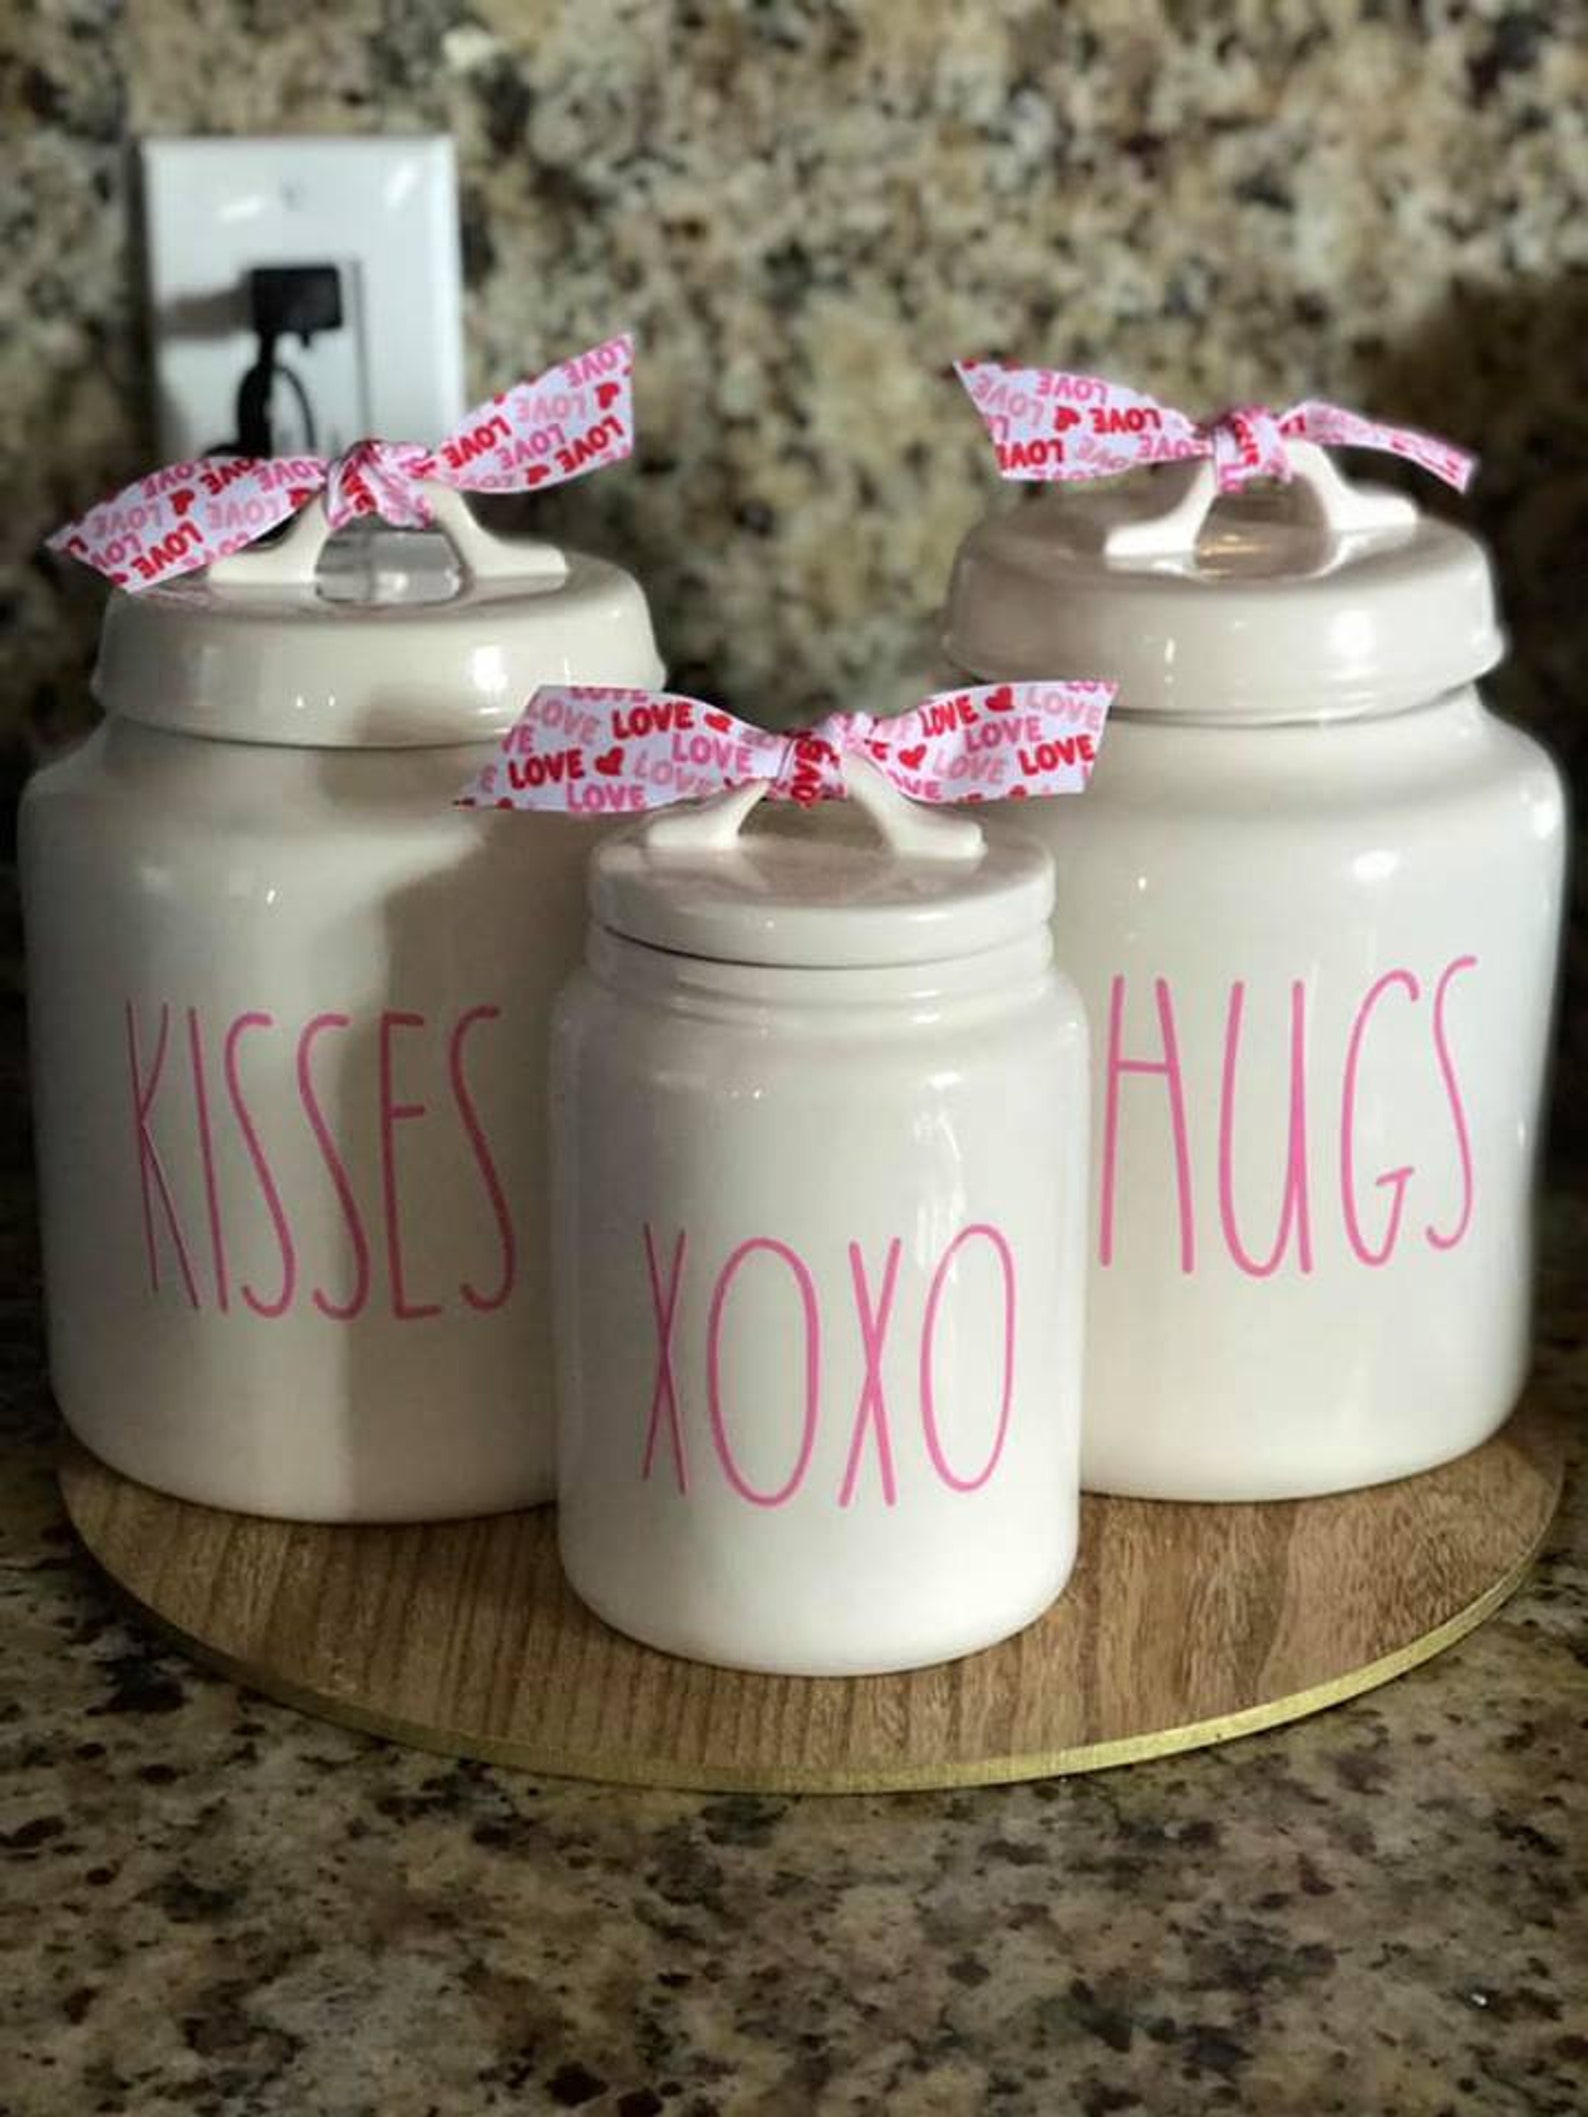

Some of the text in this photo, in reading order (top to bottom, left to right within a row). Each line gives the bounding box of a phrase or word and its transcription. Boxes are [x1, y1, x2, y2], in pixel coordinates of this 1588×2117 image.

[563, 339, 630, 388] LOVE
[972, 372, 1044, 427] LOVE
[1035, 369, 1108, 404] LOVE
[515, 395, 588, 422] LOVE
[1089, 406, 1161, 434] LOVE
[442, 415, 512, 469] LOVE
[495, 423, 566, 471] LOVE
[556, 415, 625, 473] LOVE
[95, 503, 163, 537] LOVE
[207, 500, 280, 530] LOVE
[131, 520, 204, 580] LOVE
[611, 702, 694, 740] LOVE
[918, 695, 979, 738] LOVE
[1028, 687, 1102, 730] LOVE
[672, 733, 752, 774] LOVE
[965, 716, 1042, 752] LOVE
[1017, 734, 1095, 776] LOVE
[508, 748, 586, 791] LOVE
[933, 750, 1007, 784] LOVE
[566, 783, 647, 812] LOVE
[1099, 955, 1478, 1278] HUGS
[125, 999, 516, 1320] KISSES
[641, 1221, 1018, 1508] XOXO
